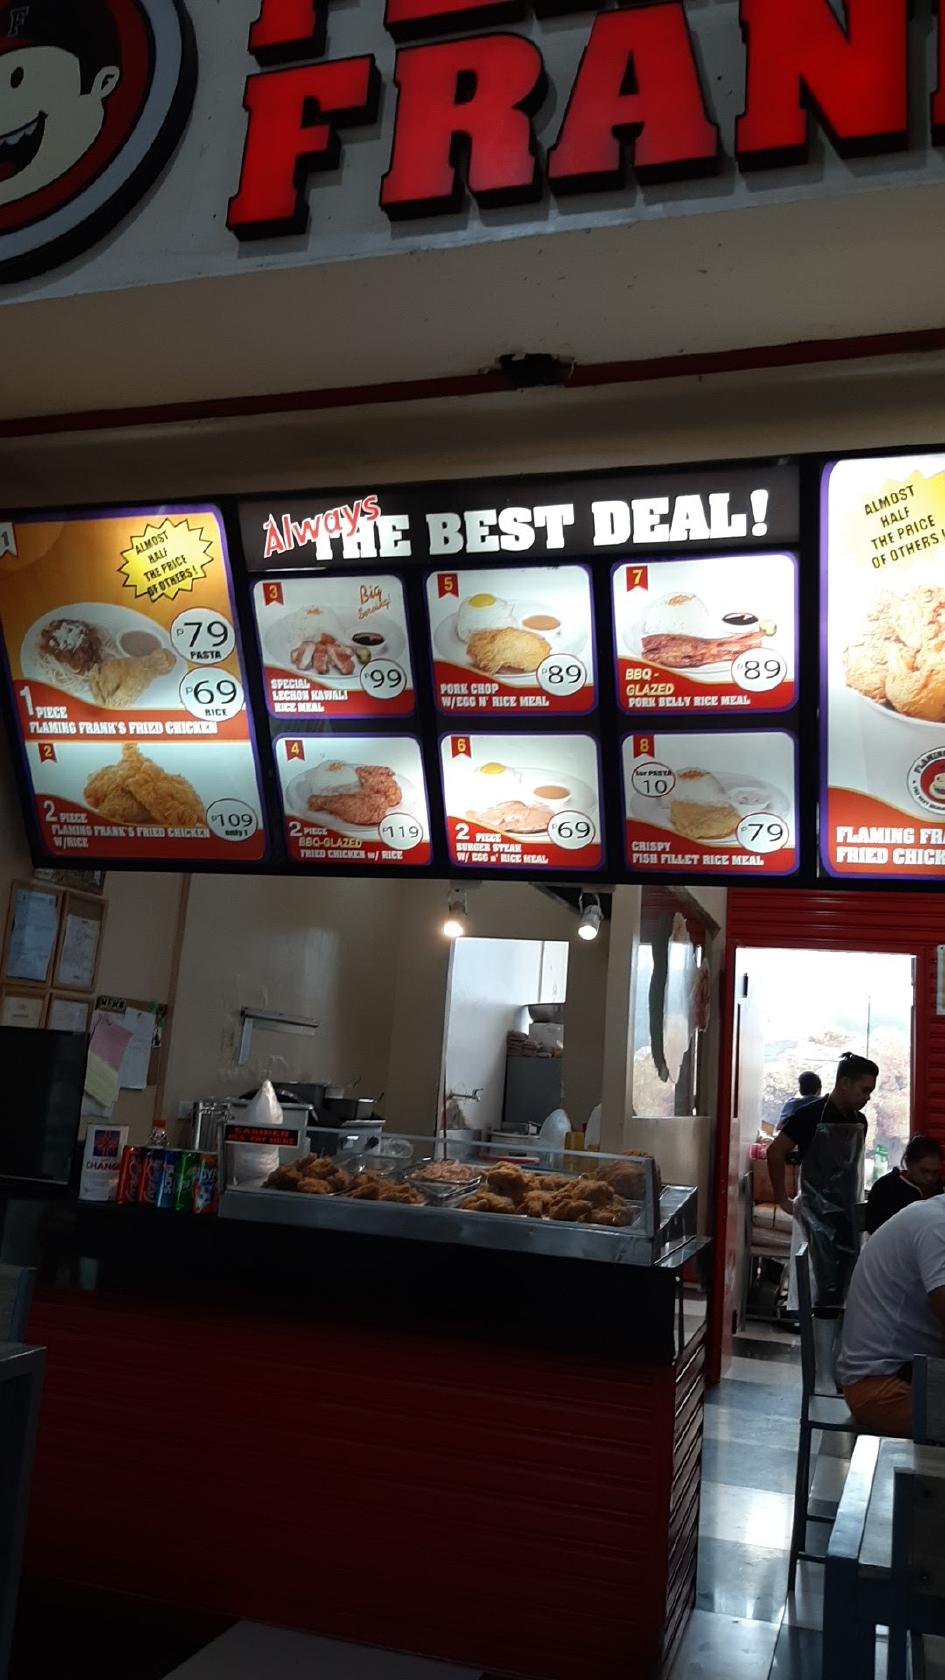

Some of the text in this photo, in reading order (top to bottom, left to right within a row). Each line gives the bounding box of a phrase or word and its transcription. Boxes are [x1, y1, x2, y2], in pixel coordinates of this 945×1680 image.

[226, 0, 945, 228] FRAN
[864, 484, 915, 516] ALMOST
[880, 506, 910, 528] HALF
[263, 495, 382, 558] Always
[313, 489, 769, 561] THE BEST DEAL!
[871, 514, 936, 550] THE PRICE
[135, 531, 168, 555] ALMOST
[148, 548, 168, 564] HALF
[871, 554, 887, 569] OF
[144, 554, 188, 583] THE PRICE
[444, 577, 453, 591] 5
[632, 569, 643, 585] 7
[269, 585, 278, 599] 3
[190, 651, 221, 660] PASTA
[271, 679, 310, 689] SPECIAL
[440, 683, 499, 695] PORK CHOP
[626, 683, 675, 696] GLAZED
[272, 689, 348, 701] LECHON KAWALI
[628, 695, 751, 707] PORK BELLY RICE MEAL
[20, 686, 68, 719] 1 PIECE
[274, 702, 325, 712] RICE MEAL
[441, 696, 477, 709] W/EGG
[492, 696, 517, 707] RICE
[519, 696, 550, 706] MEAL
[205, 708, 227, 717] RICE
[29, 721, 218, 734] FLAMING FRANK'S FRIED CHICKEN
[43, 745, 52, 757] 2
[291, 742, 300, 754] 4
[457, 738, 466, 752] 6
[640, 738, 649, 753] 8
[643, 779, 668, 794] 10
[43, 800, 88, 823] 2 PIECE
[51, 825, 211, 838] FLAMING FRANK'S FRIED CHICKEN
[288, 821, 328, 837] 2 PIECE
[455, 823, 502, 843] 2 PIECE
[836, 826, 915, 844] FLAMING
[456, 842, 522, 853] BURGER STEAK
[631, 842, 671, 852] CRISPY
[300, 850, 326, 858] FRIED
[327, 850, 365, 859] CHICKEN
[382, 850, 403, 860] RICE
[471, 853, 489, 863] EGG
[501, 854, 522, 863] RICE
[523, 855, 548, 864] MEAL
[632, 853, 764, 865] FISH FILLET RICE MEAL
[836, 846, 889, 864] FRIED
